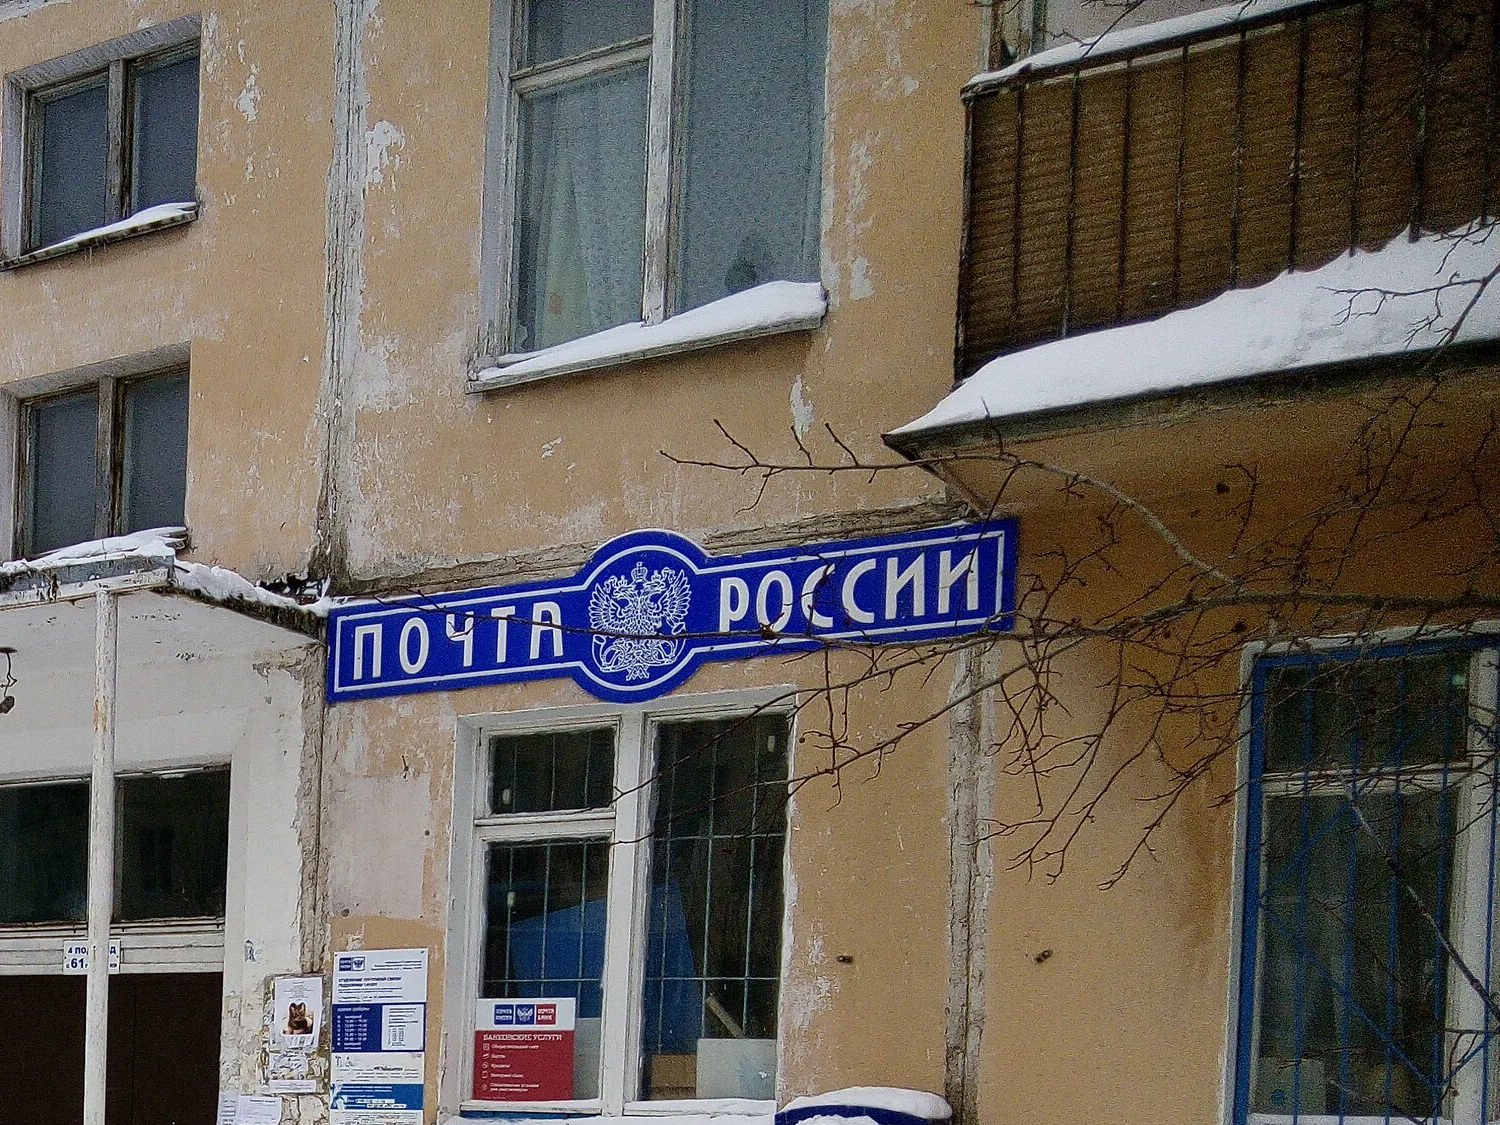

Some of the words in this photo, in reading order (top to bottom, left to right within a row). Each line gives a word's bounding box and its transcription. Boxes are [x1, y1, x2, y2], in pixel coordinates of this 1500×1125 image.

[353, 601, 564, 680] ПОЧТА
[719, 547, 979, 633] РОССИИ
[71, 958, 84, 969] 61
